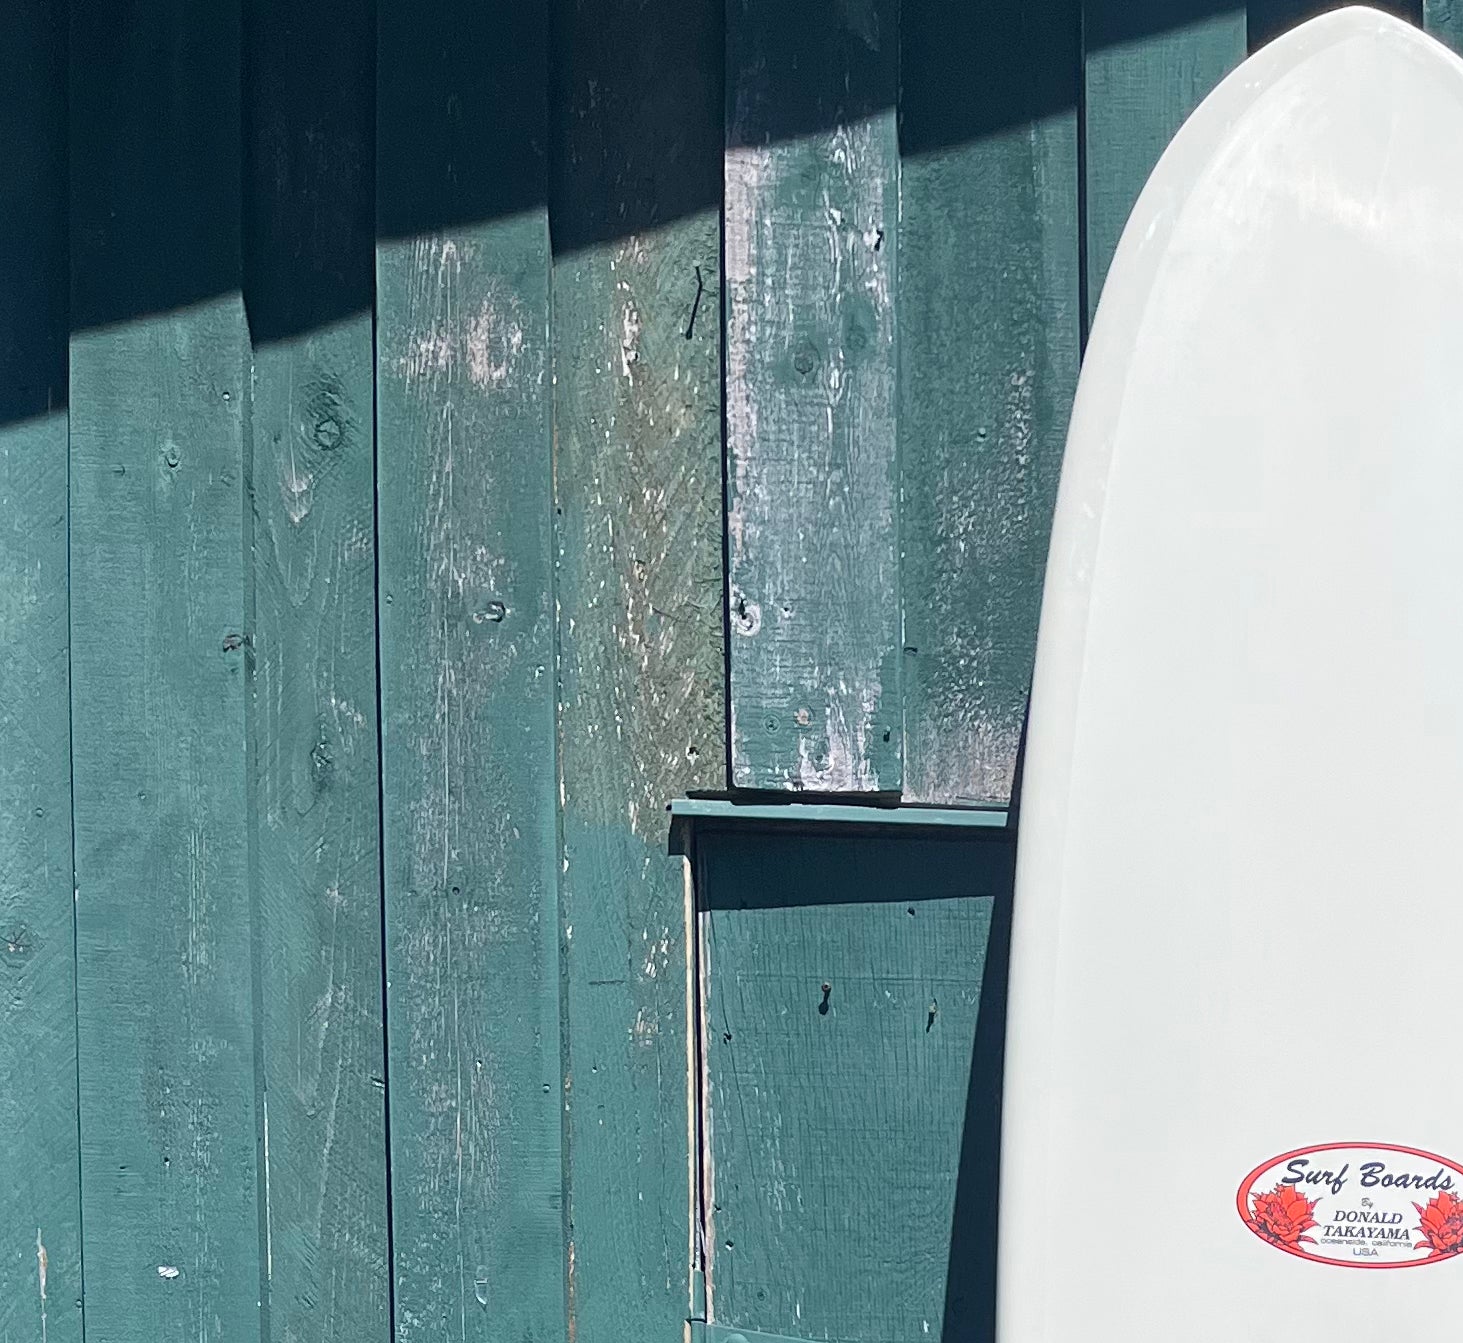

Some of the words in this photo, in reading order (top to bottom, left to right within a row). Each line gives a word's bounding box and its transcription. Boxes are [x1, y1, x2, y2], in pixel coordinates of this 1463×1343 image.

[1282, 1159, 1349, 1195] Surf
[1360, 1162, 1455, 1191] Boards
[1333, 1210, 1403, 1225] DONALD
[1323, 1225, 1411, 1240] TAKAYAMA
[1353, 1247, 1379, 1256] USA
